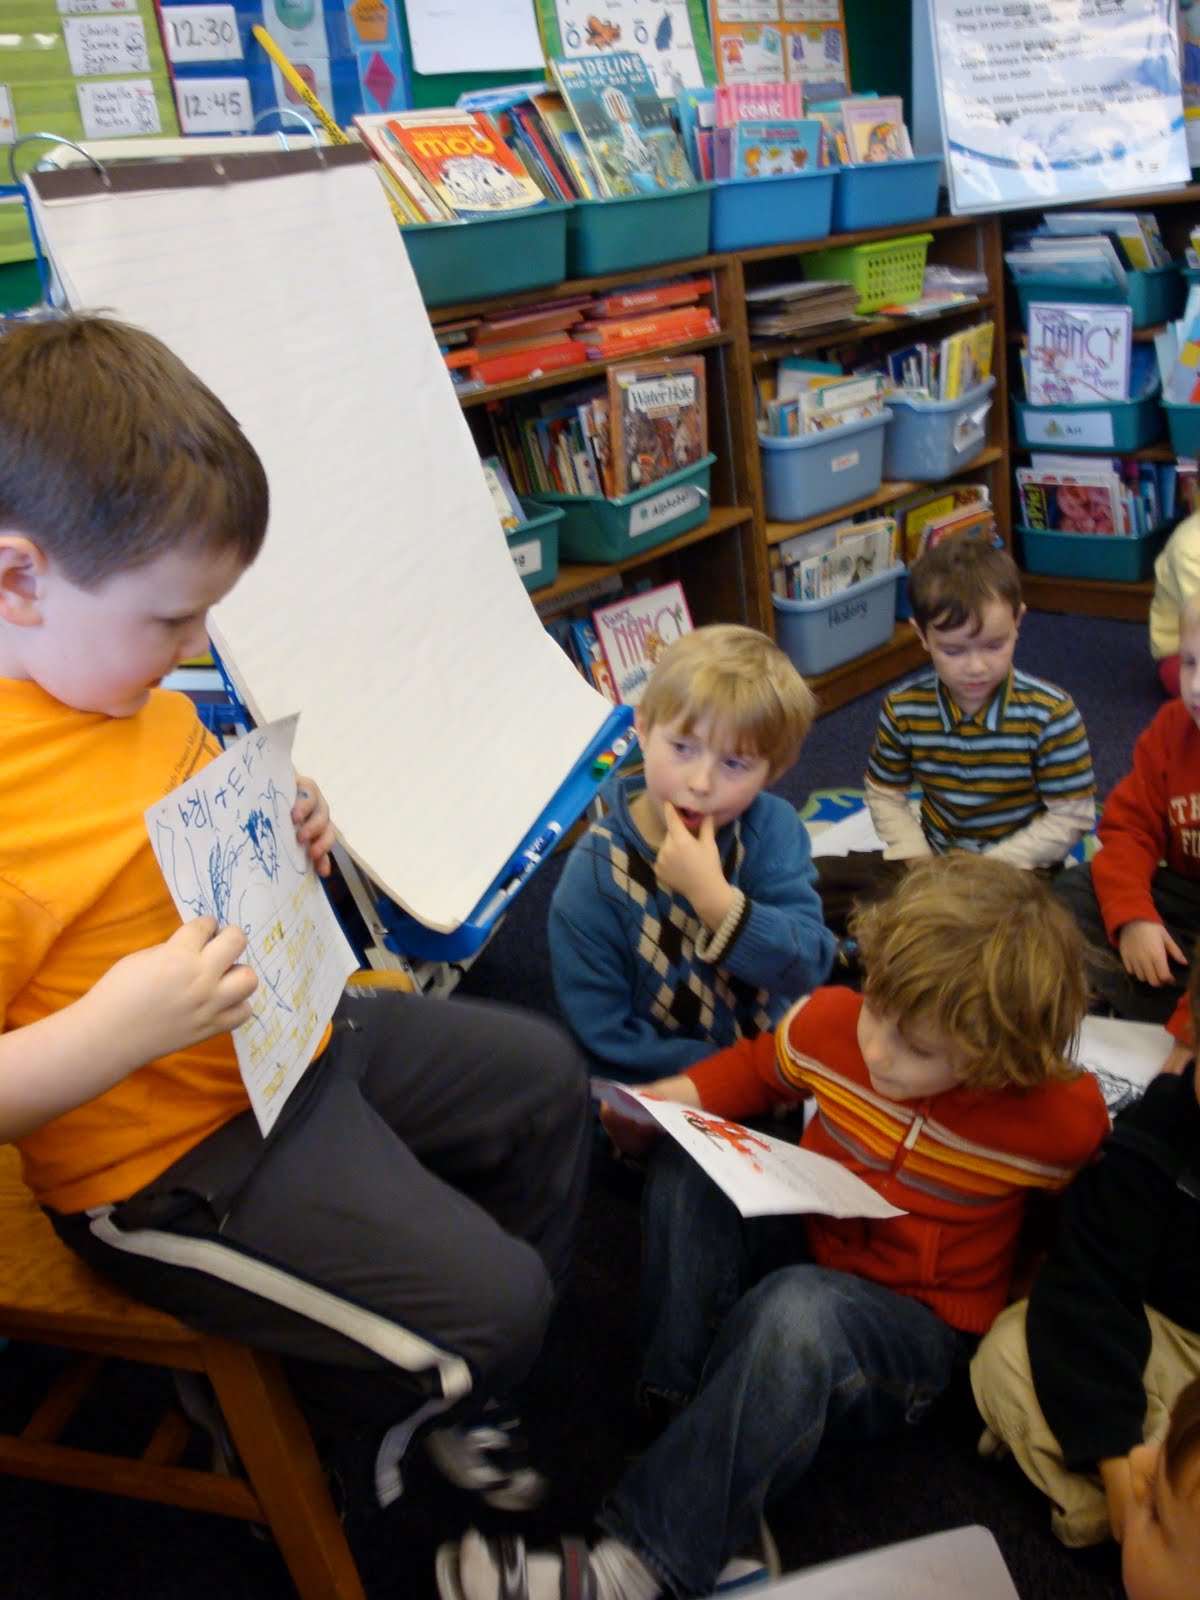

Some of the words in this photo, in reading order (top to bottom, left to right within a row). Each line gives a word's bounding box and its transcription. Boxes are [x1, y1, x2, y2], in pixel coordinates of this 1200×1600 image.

[172, 17, 236, 48] 12:30
[579, 54, 644, 78] DELINE
[184, 91, 242, 118] 12:45
[738, 103, 782, 119] COMIC
[413, 137, 496, 159] moo
[1042, 324, 1121, 369] NANCY
[612, 602, 684, 670] NANCY
